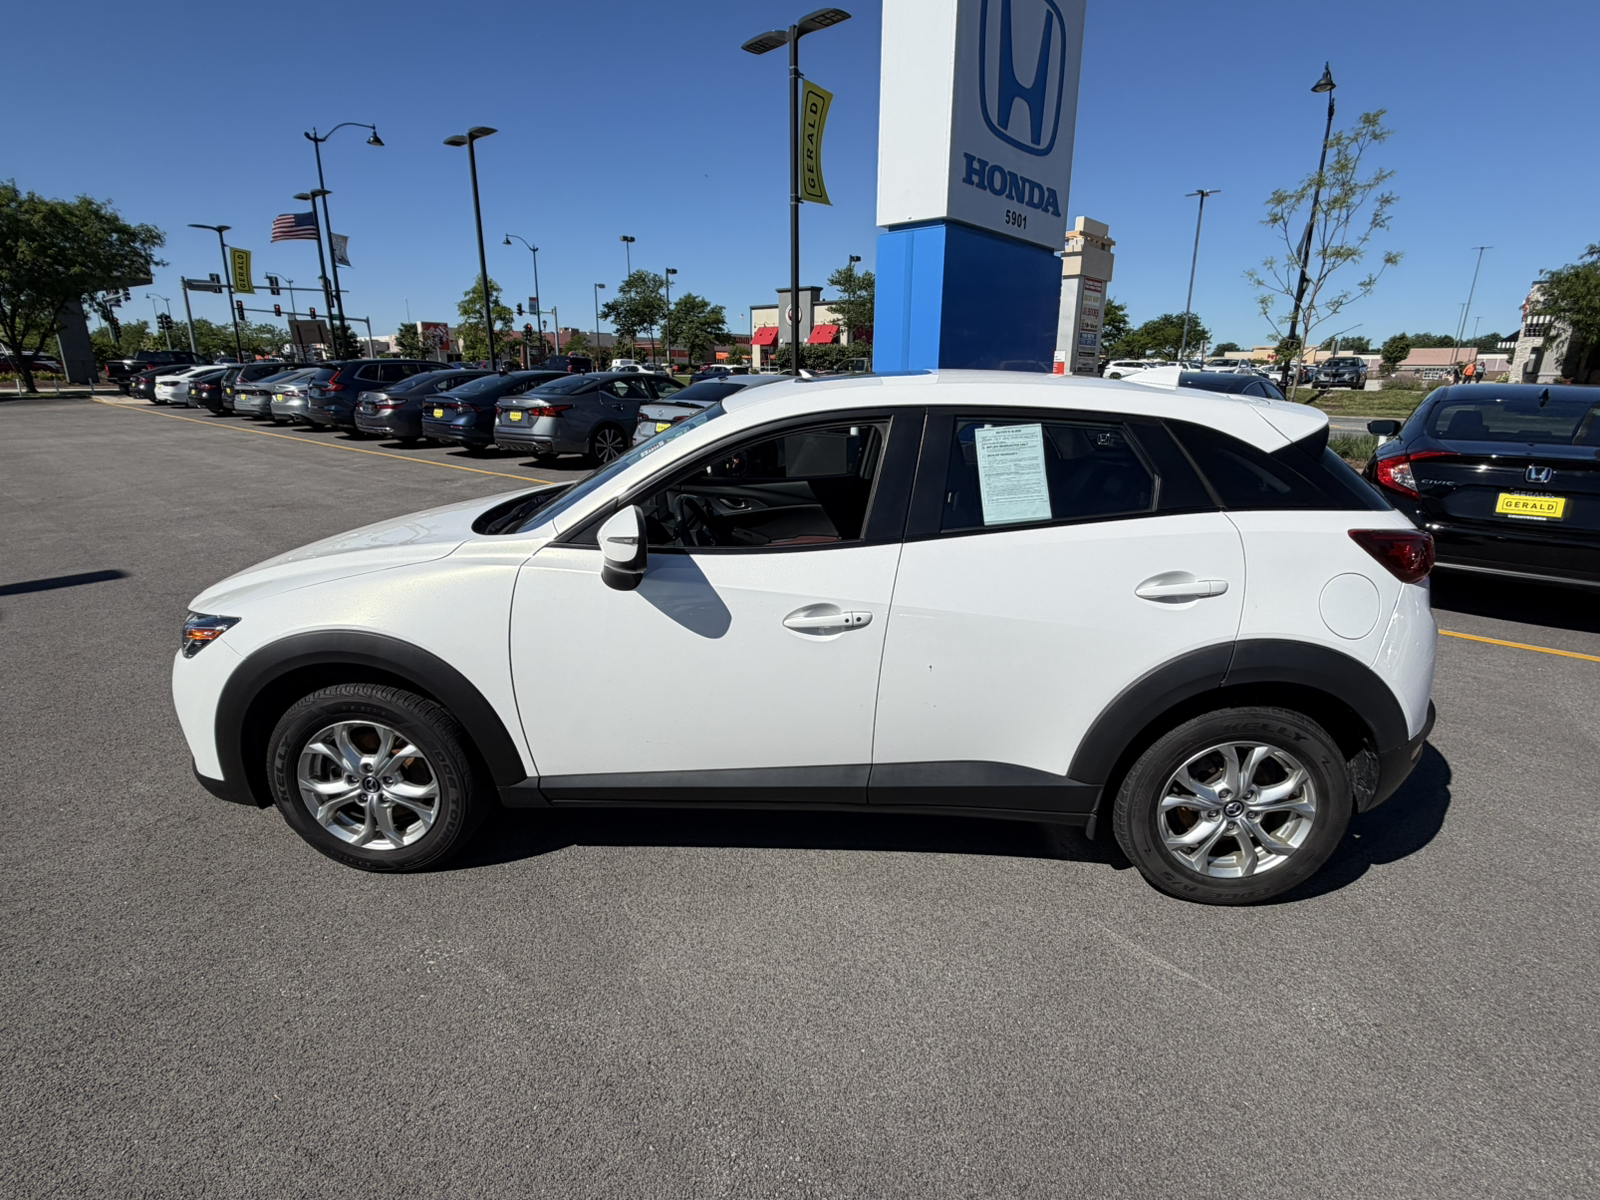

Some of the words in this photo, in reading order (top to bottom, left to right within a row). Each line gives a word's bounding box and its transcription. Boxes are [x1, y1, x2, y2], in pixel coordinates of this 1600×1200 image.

[807, 102, 818, 189] GERALD
[962, 152, 1061, 218] HONDA
[1005, 209, 1027, 230] 5901
[237, 254, 247, 289] GERALD
[1505, 501, 1555, 511] GERALD
[1222, 723, 1309, 741] KELLY
[276, 735, 290, 803] KELLY
